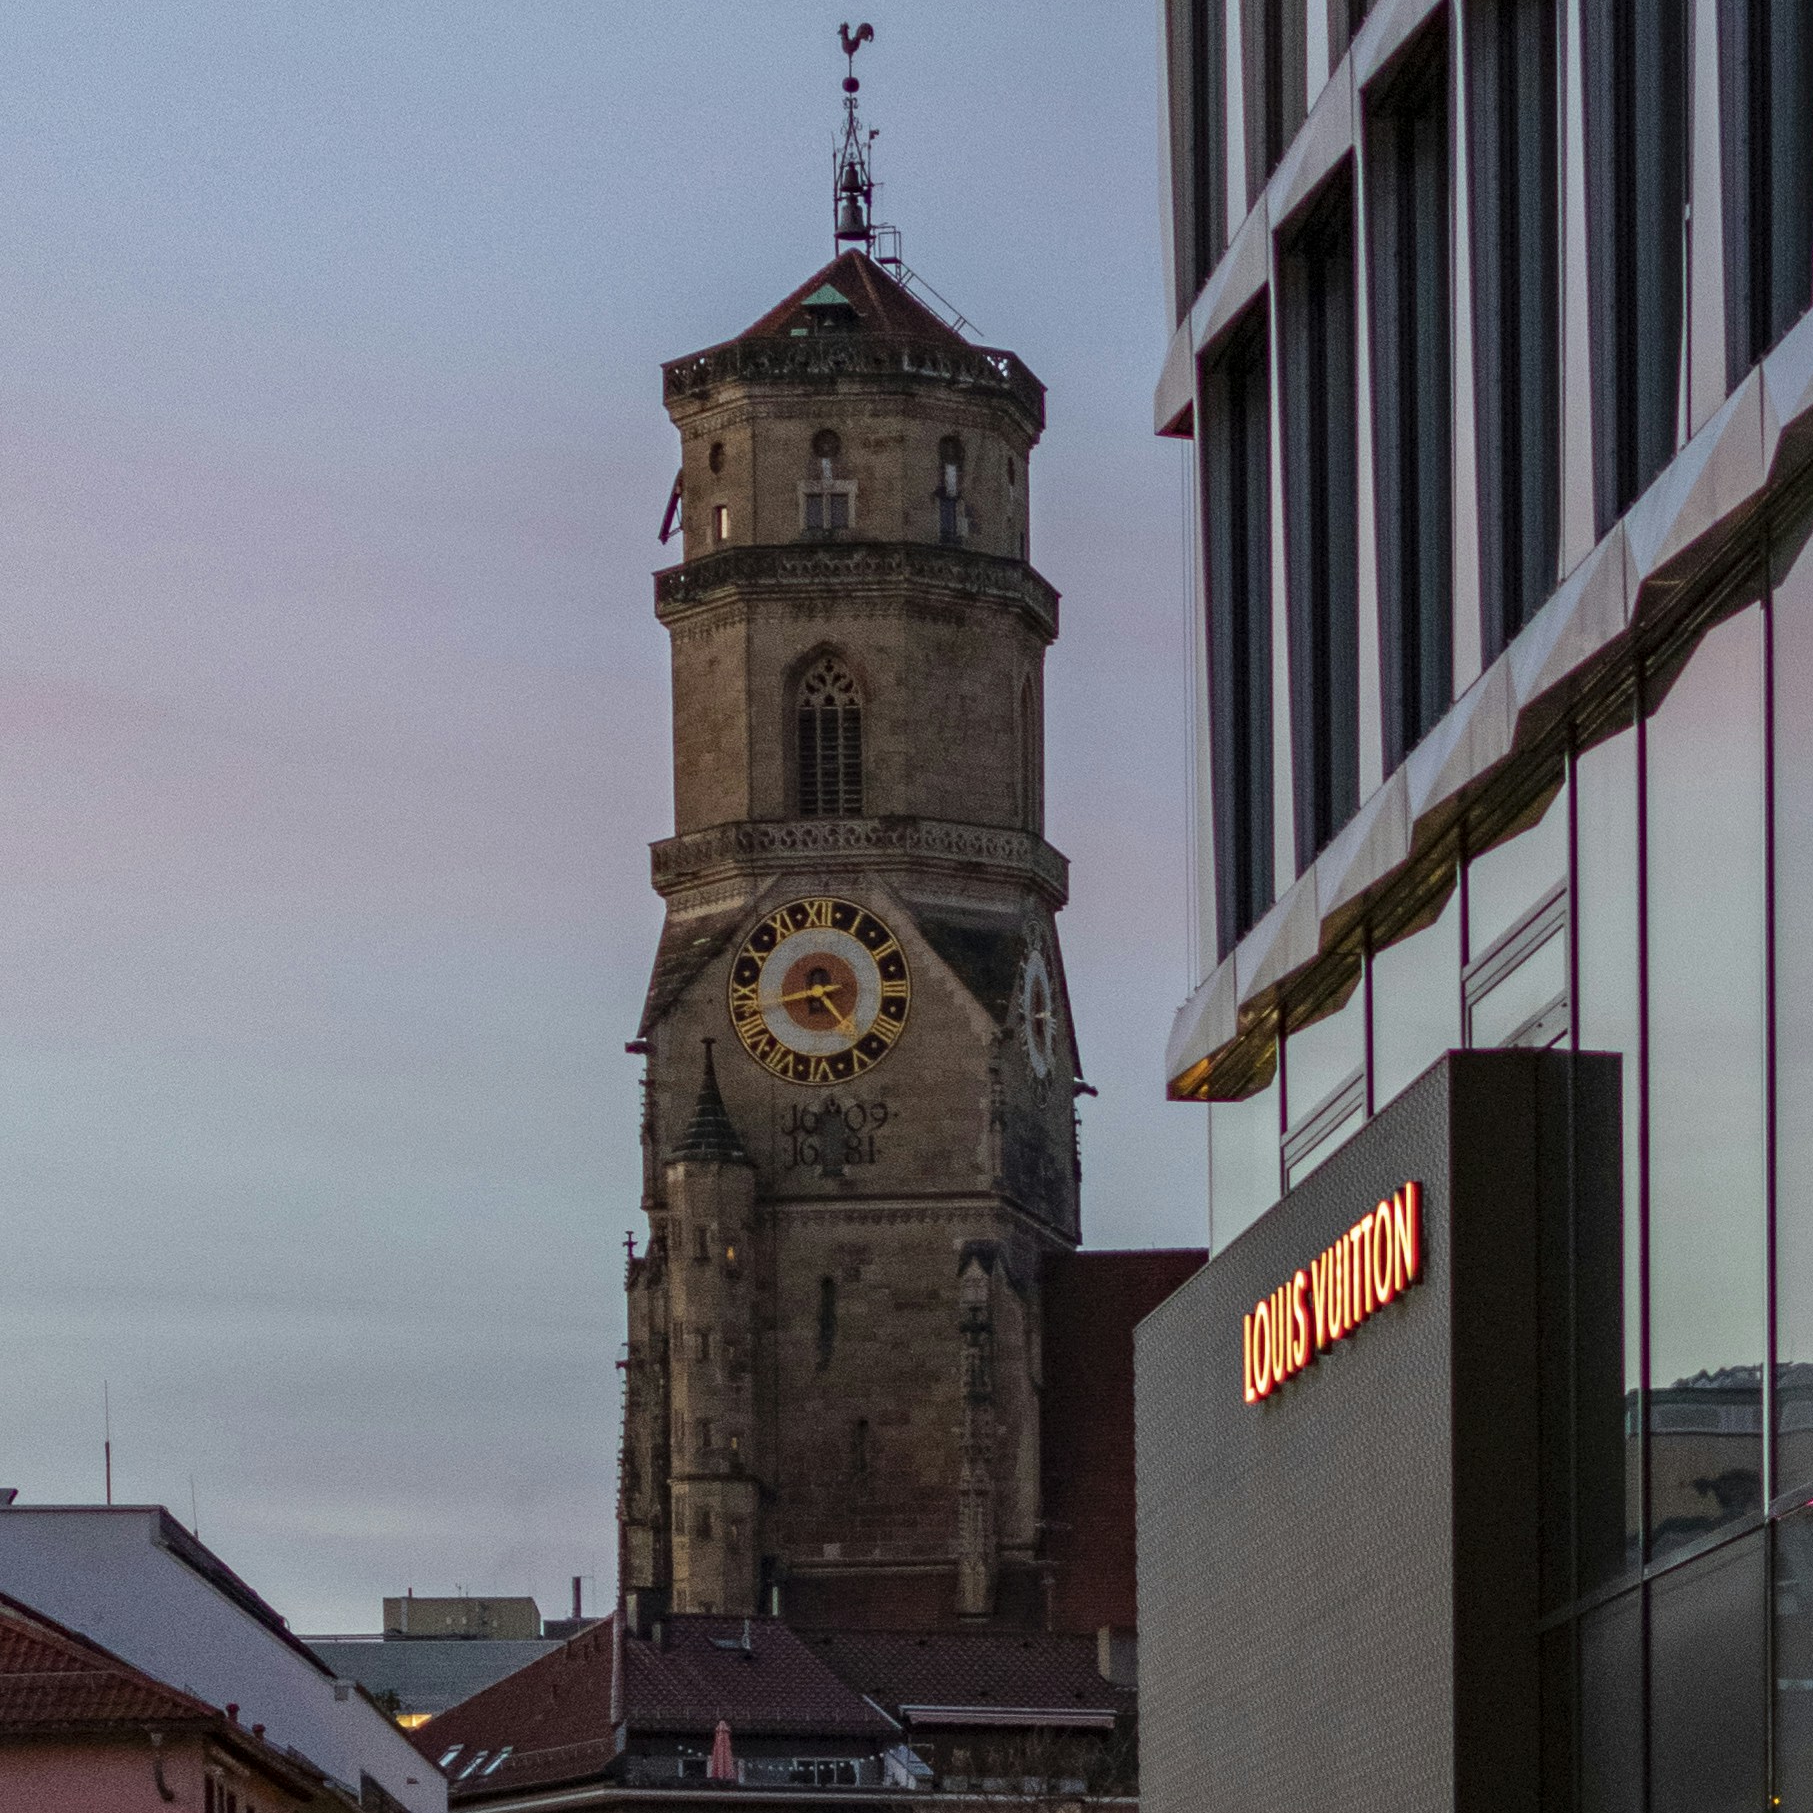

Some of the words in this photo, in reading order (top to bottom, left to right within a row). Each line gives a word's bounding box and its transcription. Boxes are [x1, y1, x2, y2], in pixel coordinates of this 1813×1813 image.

[767, 908, 795, 941] XI
[803, 900, 833, 928] XII
[848, 909, 865, 935] I
[742, 943, 769, 966] X
[872, 939, 899, 961] II
[882, 980, 908, 997] III
[766, 1046, 795, 1078] VII
[807, 1057, 835, 1082] VI
[850, 1047, 875, 1072] V
[1243, 1269, 1312, 1405] LOUIS
[1310, 1181, 1423, 1351] VUITTON
